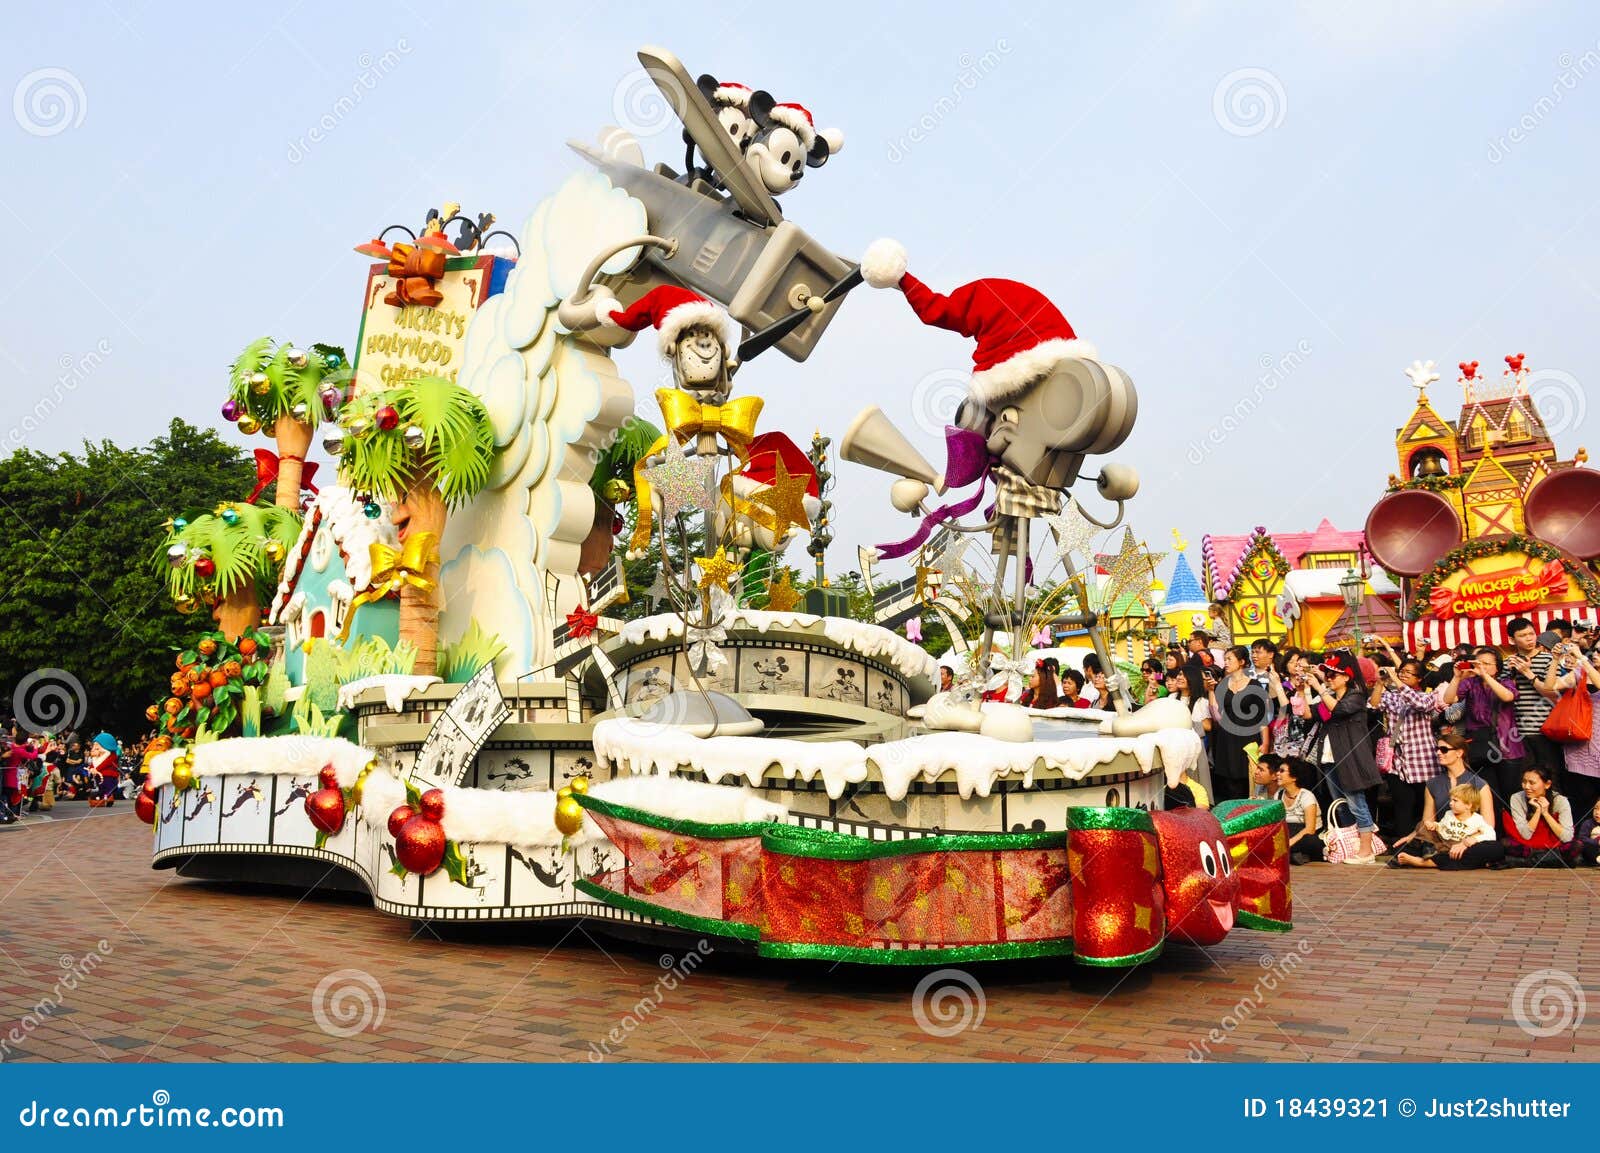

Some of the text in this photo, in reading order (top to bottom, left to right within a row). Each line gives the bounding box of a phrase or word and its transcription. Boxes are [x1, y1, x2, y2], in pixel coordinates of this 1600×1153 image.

[367, 333, 452, 365] HOLLYWOOD
[1461, 574, 1534, 597] MICKEY'S
[1453, 587, 1549, 613] CANDY SHOP
